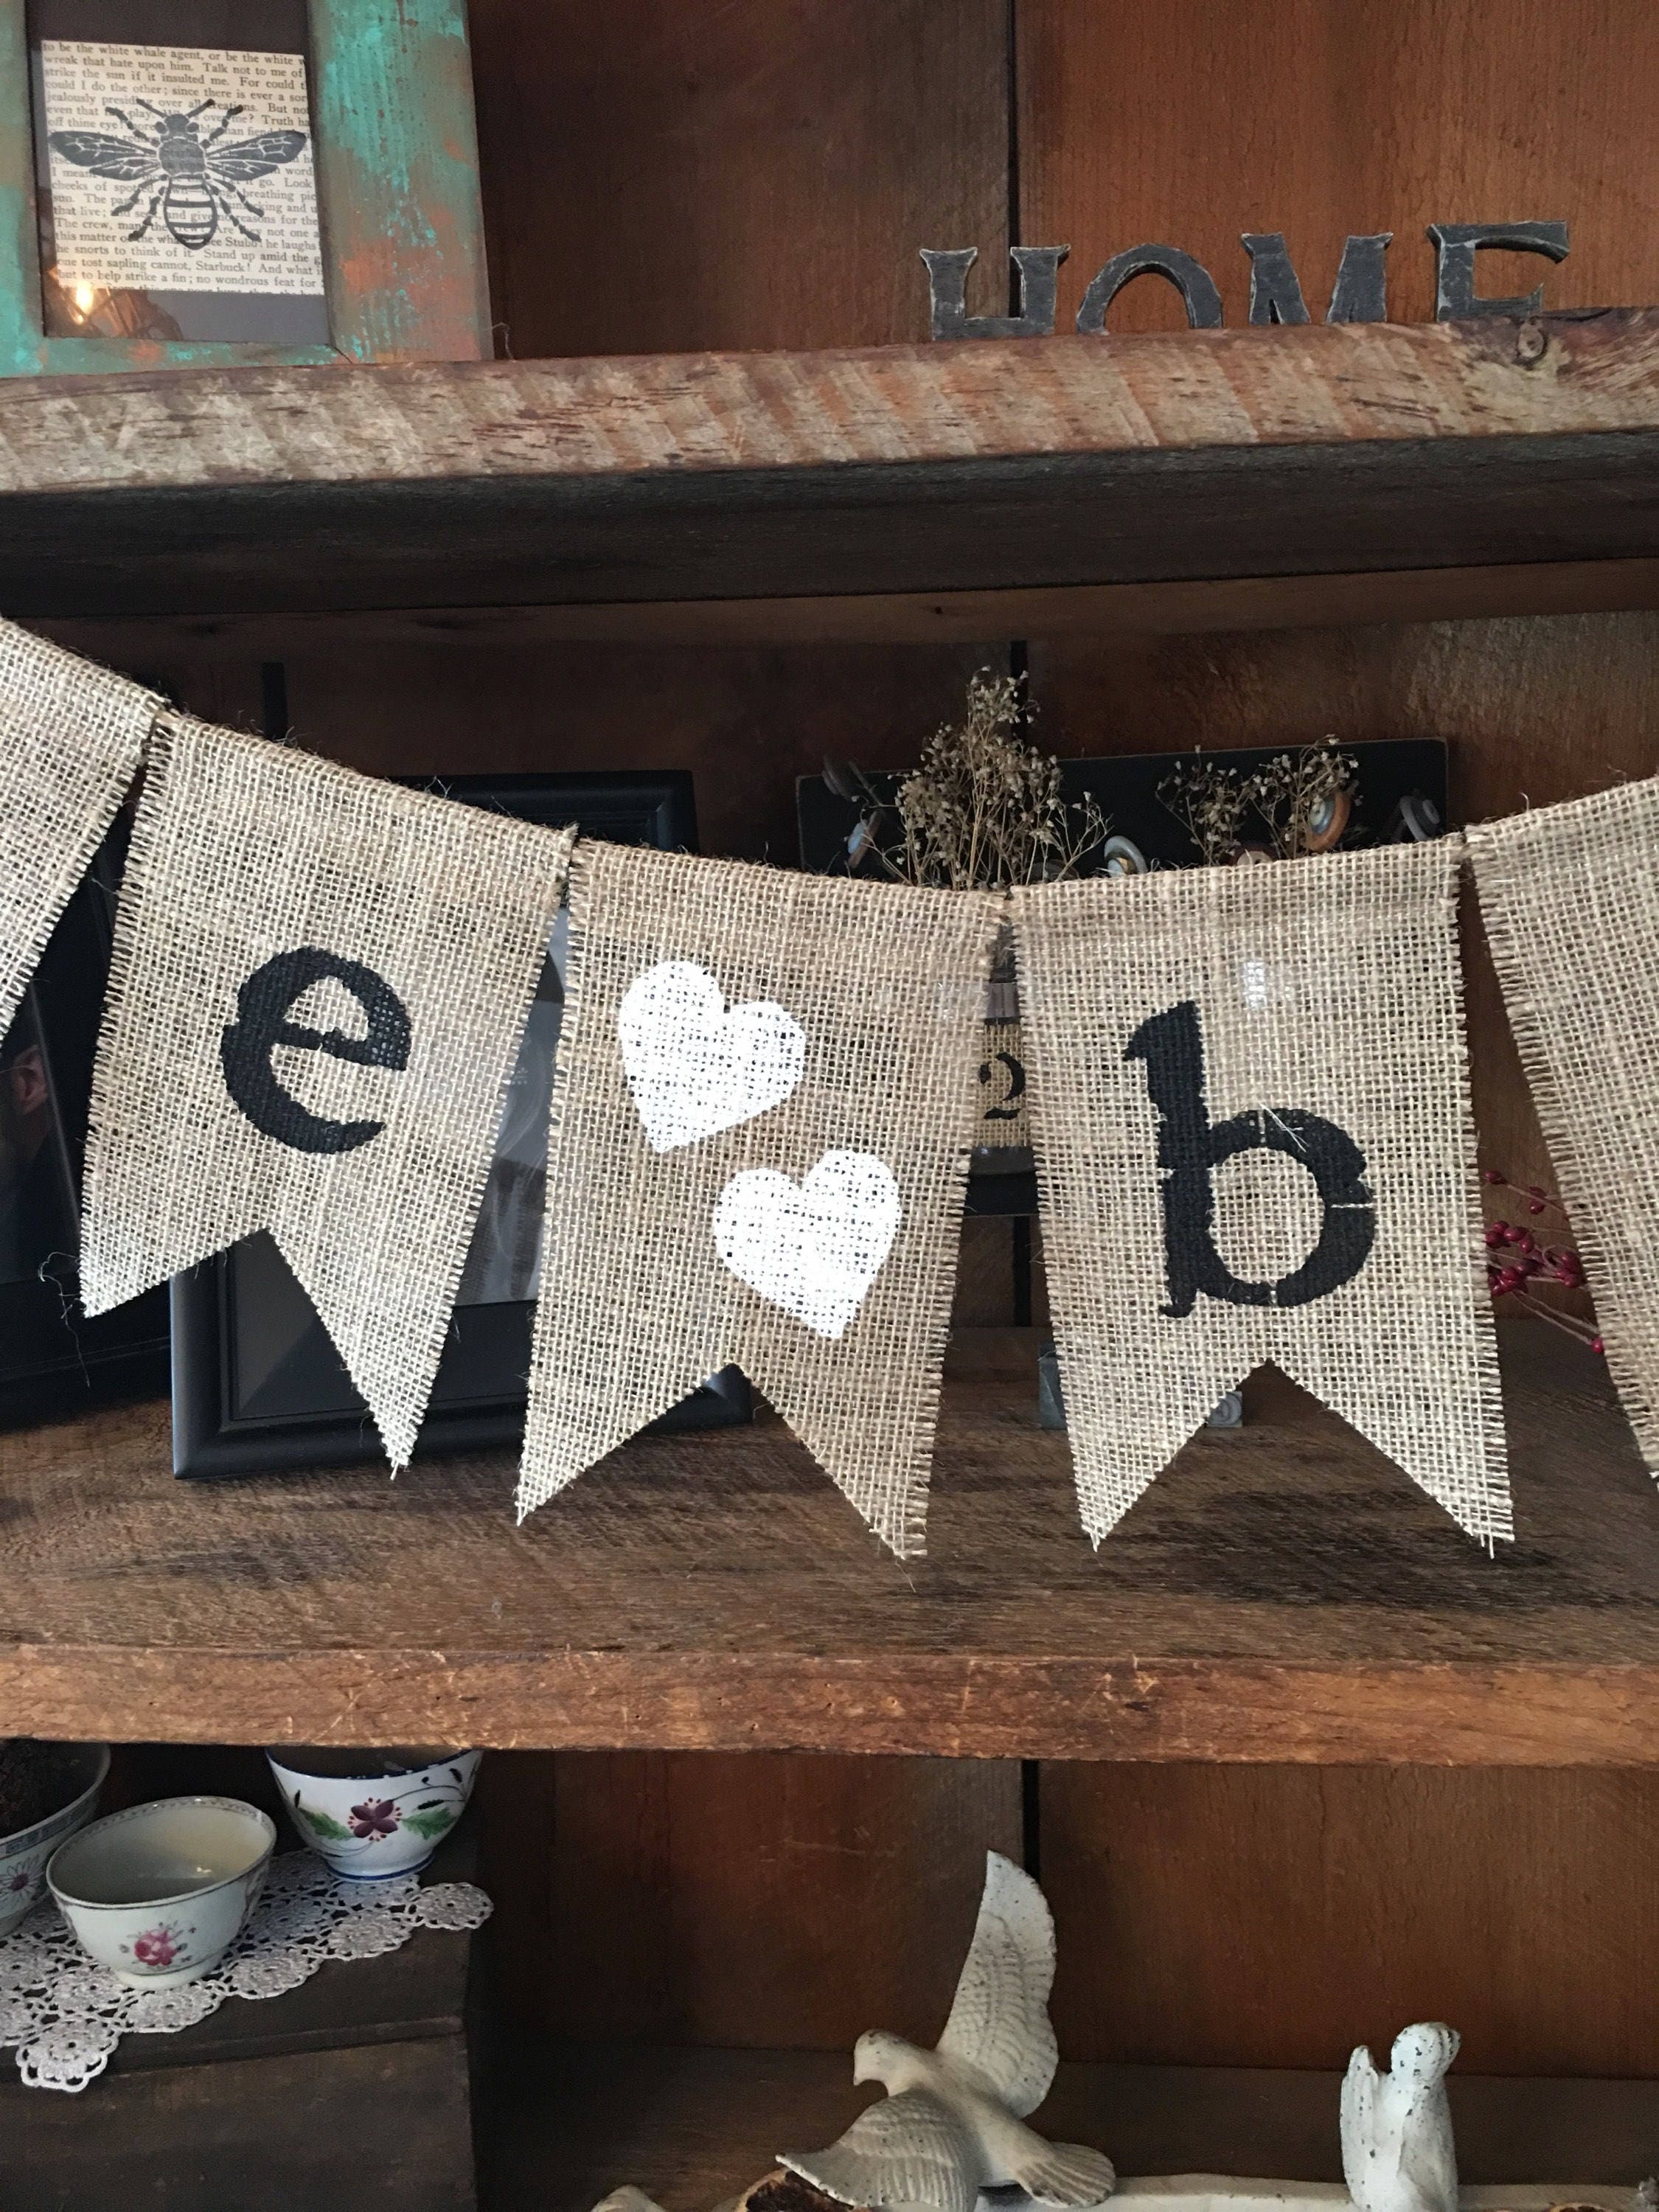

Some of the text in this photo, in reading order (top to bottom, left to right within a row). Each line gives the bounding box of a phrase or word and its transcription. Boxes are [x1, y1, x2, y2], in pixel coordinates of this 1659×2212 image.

[43, 42, 55, 52] to
[59, 43, 71, 52] be
[77, 44, 93, 53] the
[99, 45, 129, 55] white
[134, 46, 166, 58] whale
[171, 49, 204, 60] agent,
[226, 52, 237, 62] be
[243, 53, 259, 63] the
[264, 55, 293, 65] white
[44, 55, 78, 64] wreak
[83, 57, 105, 66] that
[110, 58, 133, 68] hate
[138, 61, 165, 70] upon
[202, 62, 228, 73] Talk
[233, 64, 251, 74] not
[255, 66, 266, 75] to
[271, 68, 287, 77] me
[291, 69, 303, 77] of
[44, 68, 76, 77] strike
[83, 69, 100, 78] the
[131, 70, 141, 80] if
[147, 72, 156, 81] it
[161, 72, 204, 84] insulted
[211, 77, 230, 86] me.
[240, 77, 260, 87] For
[265, 80, 295, 89] could
[45, 80, 75, 89] could
[81, 80, 86, 90] I
[91, 80, 105, 91] do
[111, 83, 128, 92] the
[172, 85, 199, 97] since
[204, 87, 232, 98] there
[236, 90, 246, 99] is
[46, 92, 97, 105] jealously
[158, 100, 182, 108] over
[268, 102, 288, 114] But
[68, 119, 96, 128] thine
[77, 106, 99, 116] that
[261, 115, 294, 126] Truth
[52, 180, 88, 189] cheeks
[94, 181, 107, 191] of
[243, 189, 294, 202] breathing
[83, 193, 107, 203] The
[287, 204, 306, 212] and
[53, 206, 76, 216] that
[281, 214, 297, 223] for
[55, 218, 77, 228] The
[267, 228, 285, 237] not
[55, 232, 77, 241] this
[80, 232, 116, 242] matter
[265, 239, 278, 248] he
[56, 244, 69, 253] he
[74, 246, 110, 254] snorts
[114, 246, 127, 255] to
[131, 246, 161, 257] think
[165, 247, 178, 257] of
[204, 248, 237, 258] Stand
[241, 252, 255, 262] up
[260, 251, 288, 261] amid
[292, 252, 309, 262] the
[82, 258, 102, 267] tost
[107, 259, 147, 270] sapling
[195, 260, 250, 272] Starbuck!
[259, 263, 282, 274] And
[286, 265, 313, 275] what
[58, 269, 77, 279] but
[82, 270, 93, 279] to
[98, 270, 121, 282] help
[125, 271, 157, 282] strike
[196, 276, 211, 284] no
[215, 275, 268, 285] wondrous
[274, 276, 295, 287] feat
[300, 278, 316, 288] for
[919, 220, 1570, 341] HOME
[224, 947, 1374, 1318] e b
